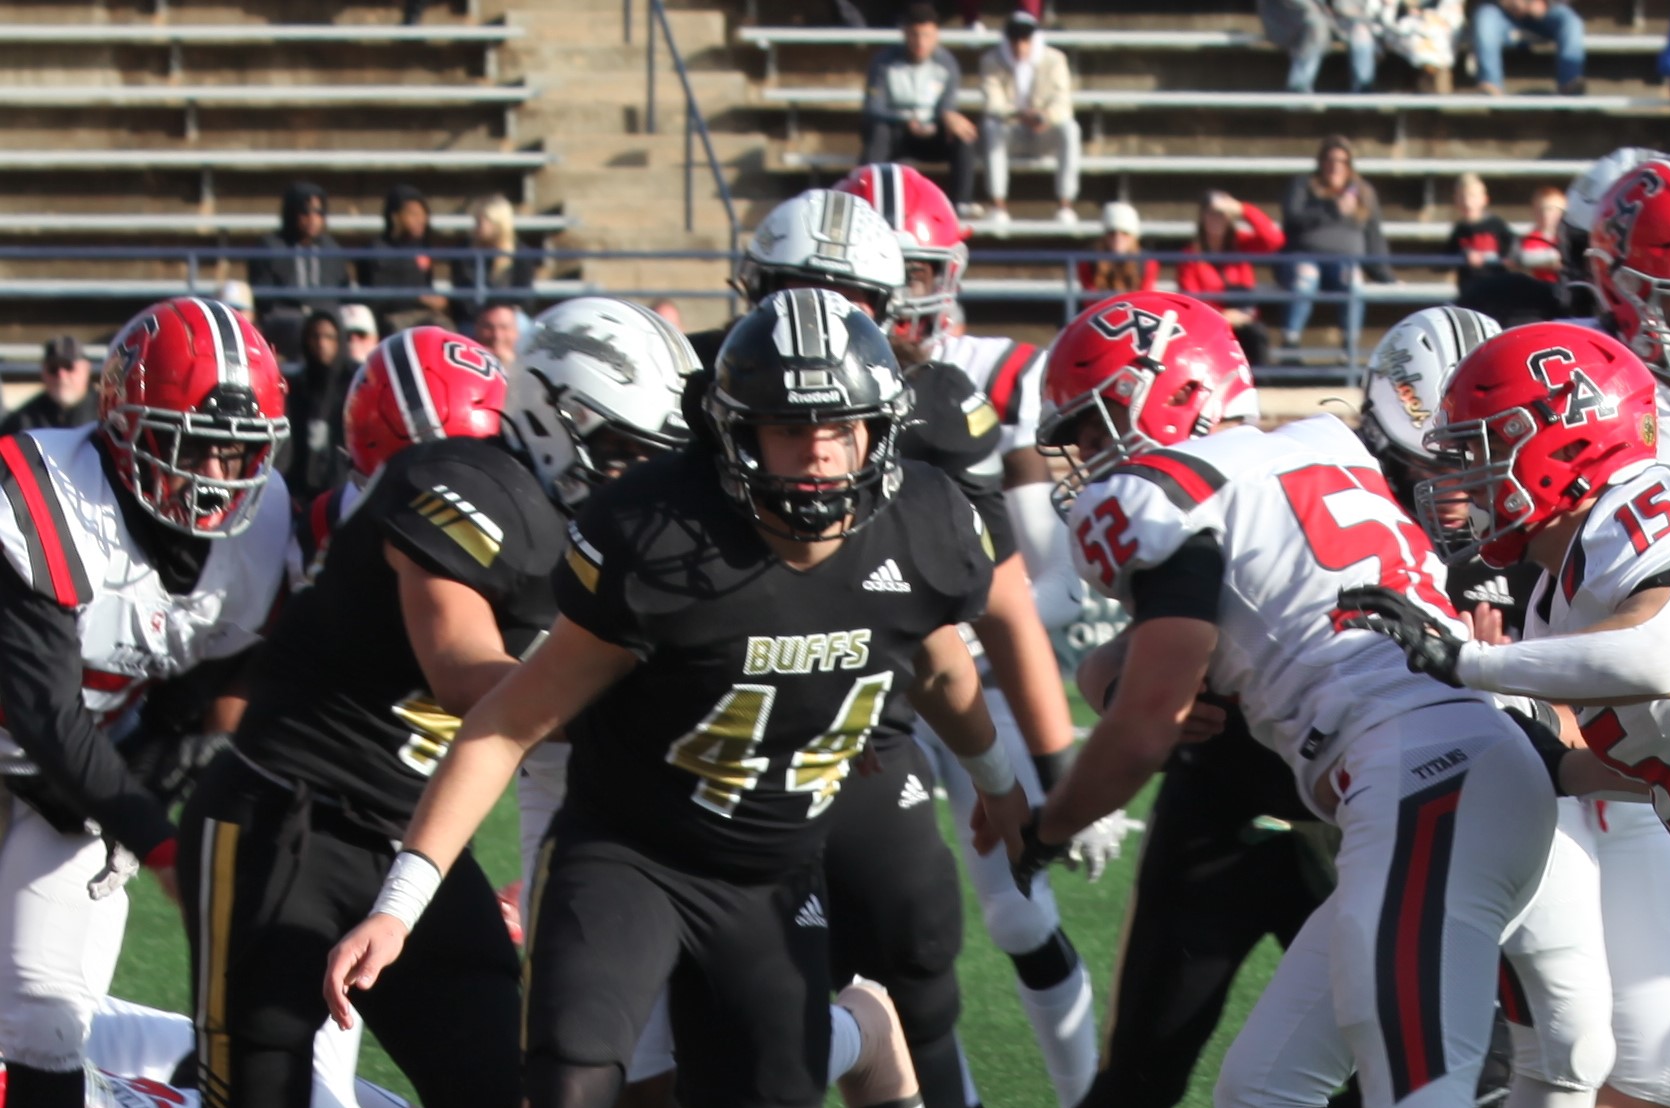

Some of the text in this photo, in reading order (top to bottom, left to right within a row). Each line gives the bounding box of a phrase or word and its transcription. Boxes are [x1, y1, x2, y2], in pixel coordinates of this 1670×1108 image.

[1088, 301, 1187, 356] CA
[1527, 346, 1618, 429] CA
[1076, 496, 1140, 588] 52
[1276, 462, 1462, 635] 52
[743, 628, 872, 676] BUFFS
[665, 670, 894, 819] 44
[1411, 748, 1468, 779] TITANS
